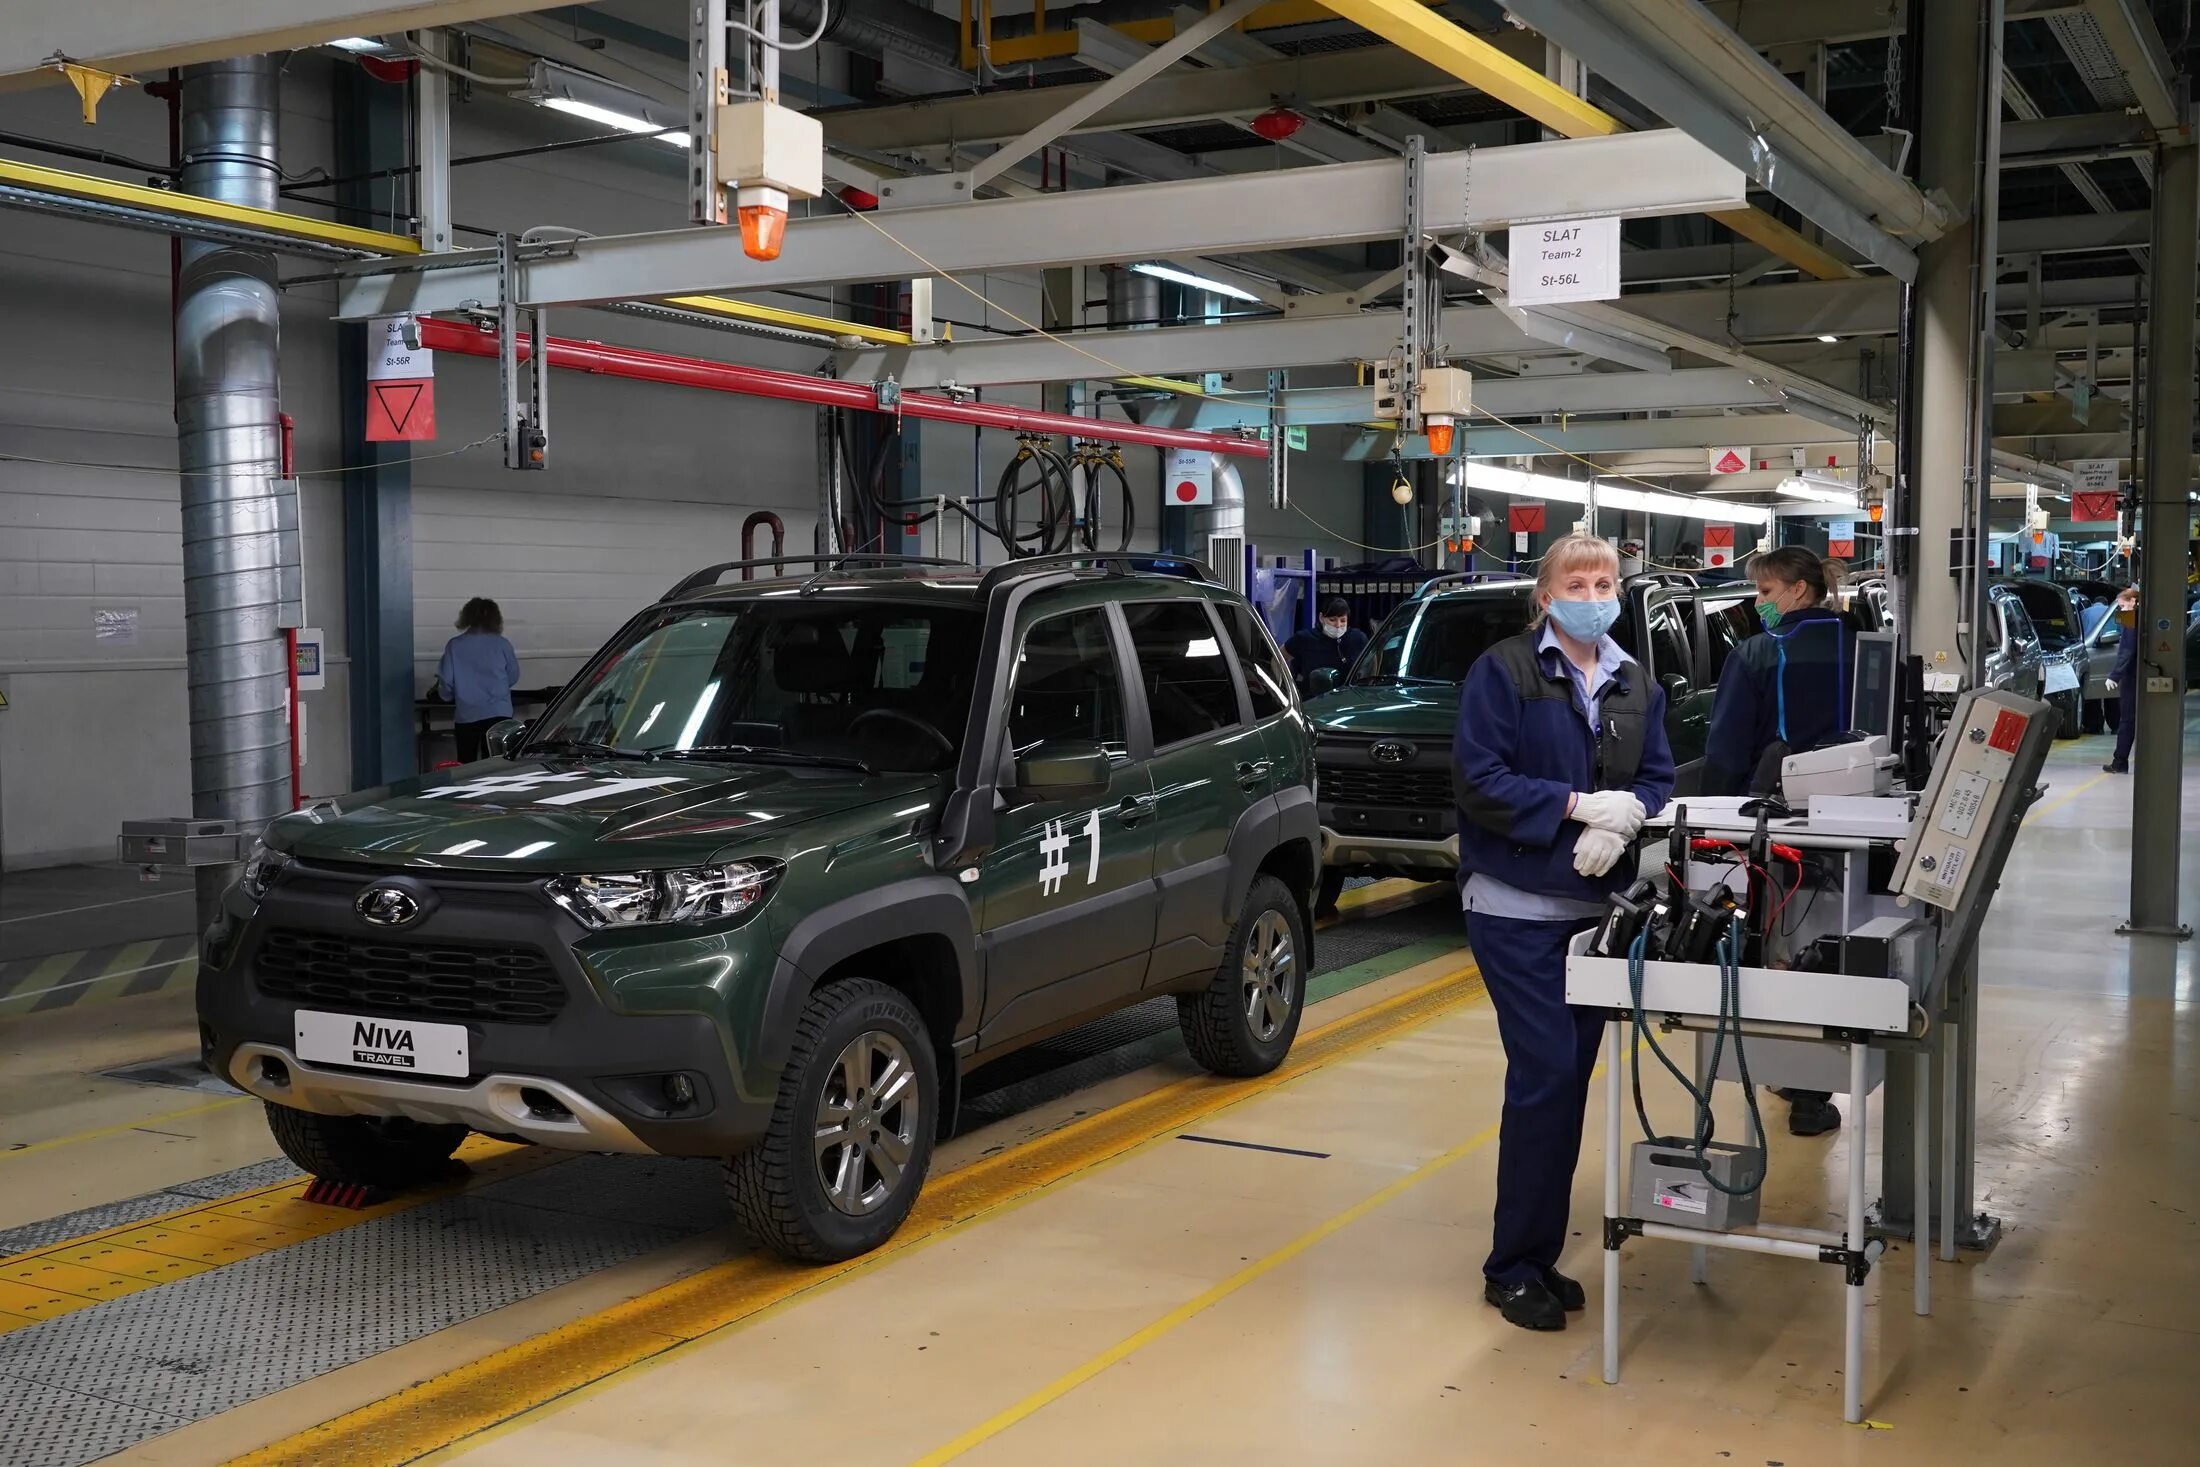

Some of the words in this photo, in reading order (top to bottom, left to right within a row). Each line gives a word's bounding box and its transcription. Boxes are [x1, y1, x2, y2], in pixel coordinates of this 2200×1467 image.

[1543, 228, 1581, 242] SLAT
[1541, 248, 1582, 260] Team-2
[1541, 274, 1580, 286] St-56L
[387, 323, 403, 333] SLA
[386, 356, 411, 367] St-56R
[416, 771, 690, 805] #1
[1039, 808, 1100, 896] #1
[353, 1021, 415, 1051] NIVA
[357, 1052, 411, 1066] TRAVEL
